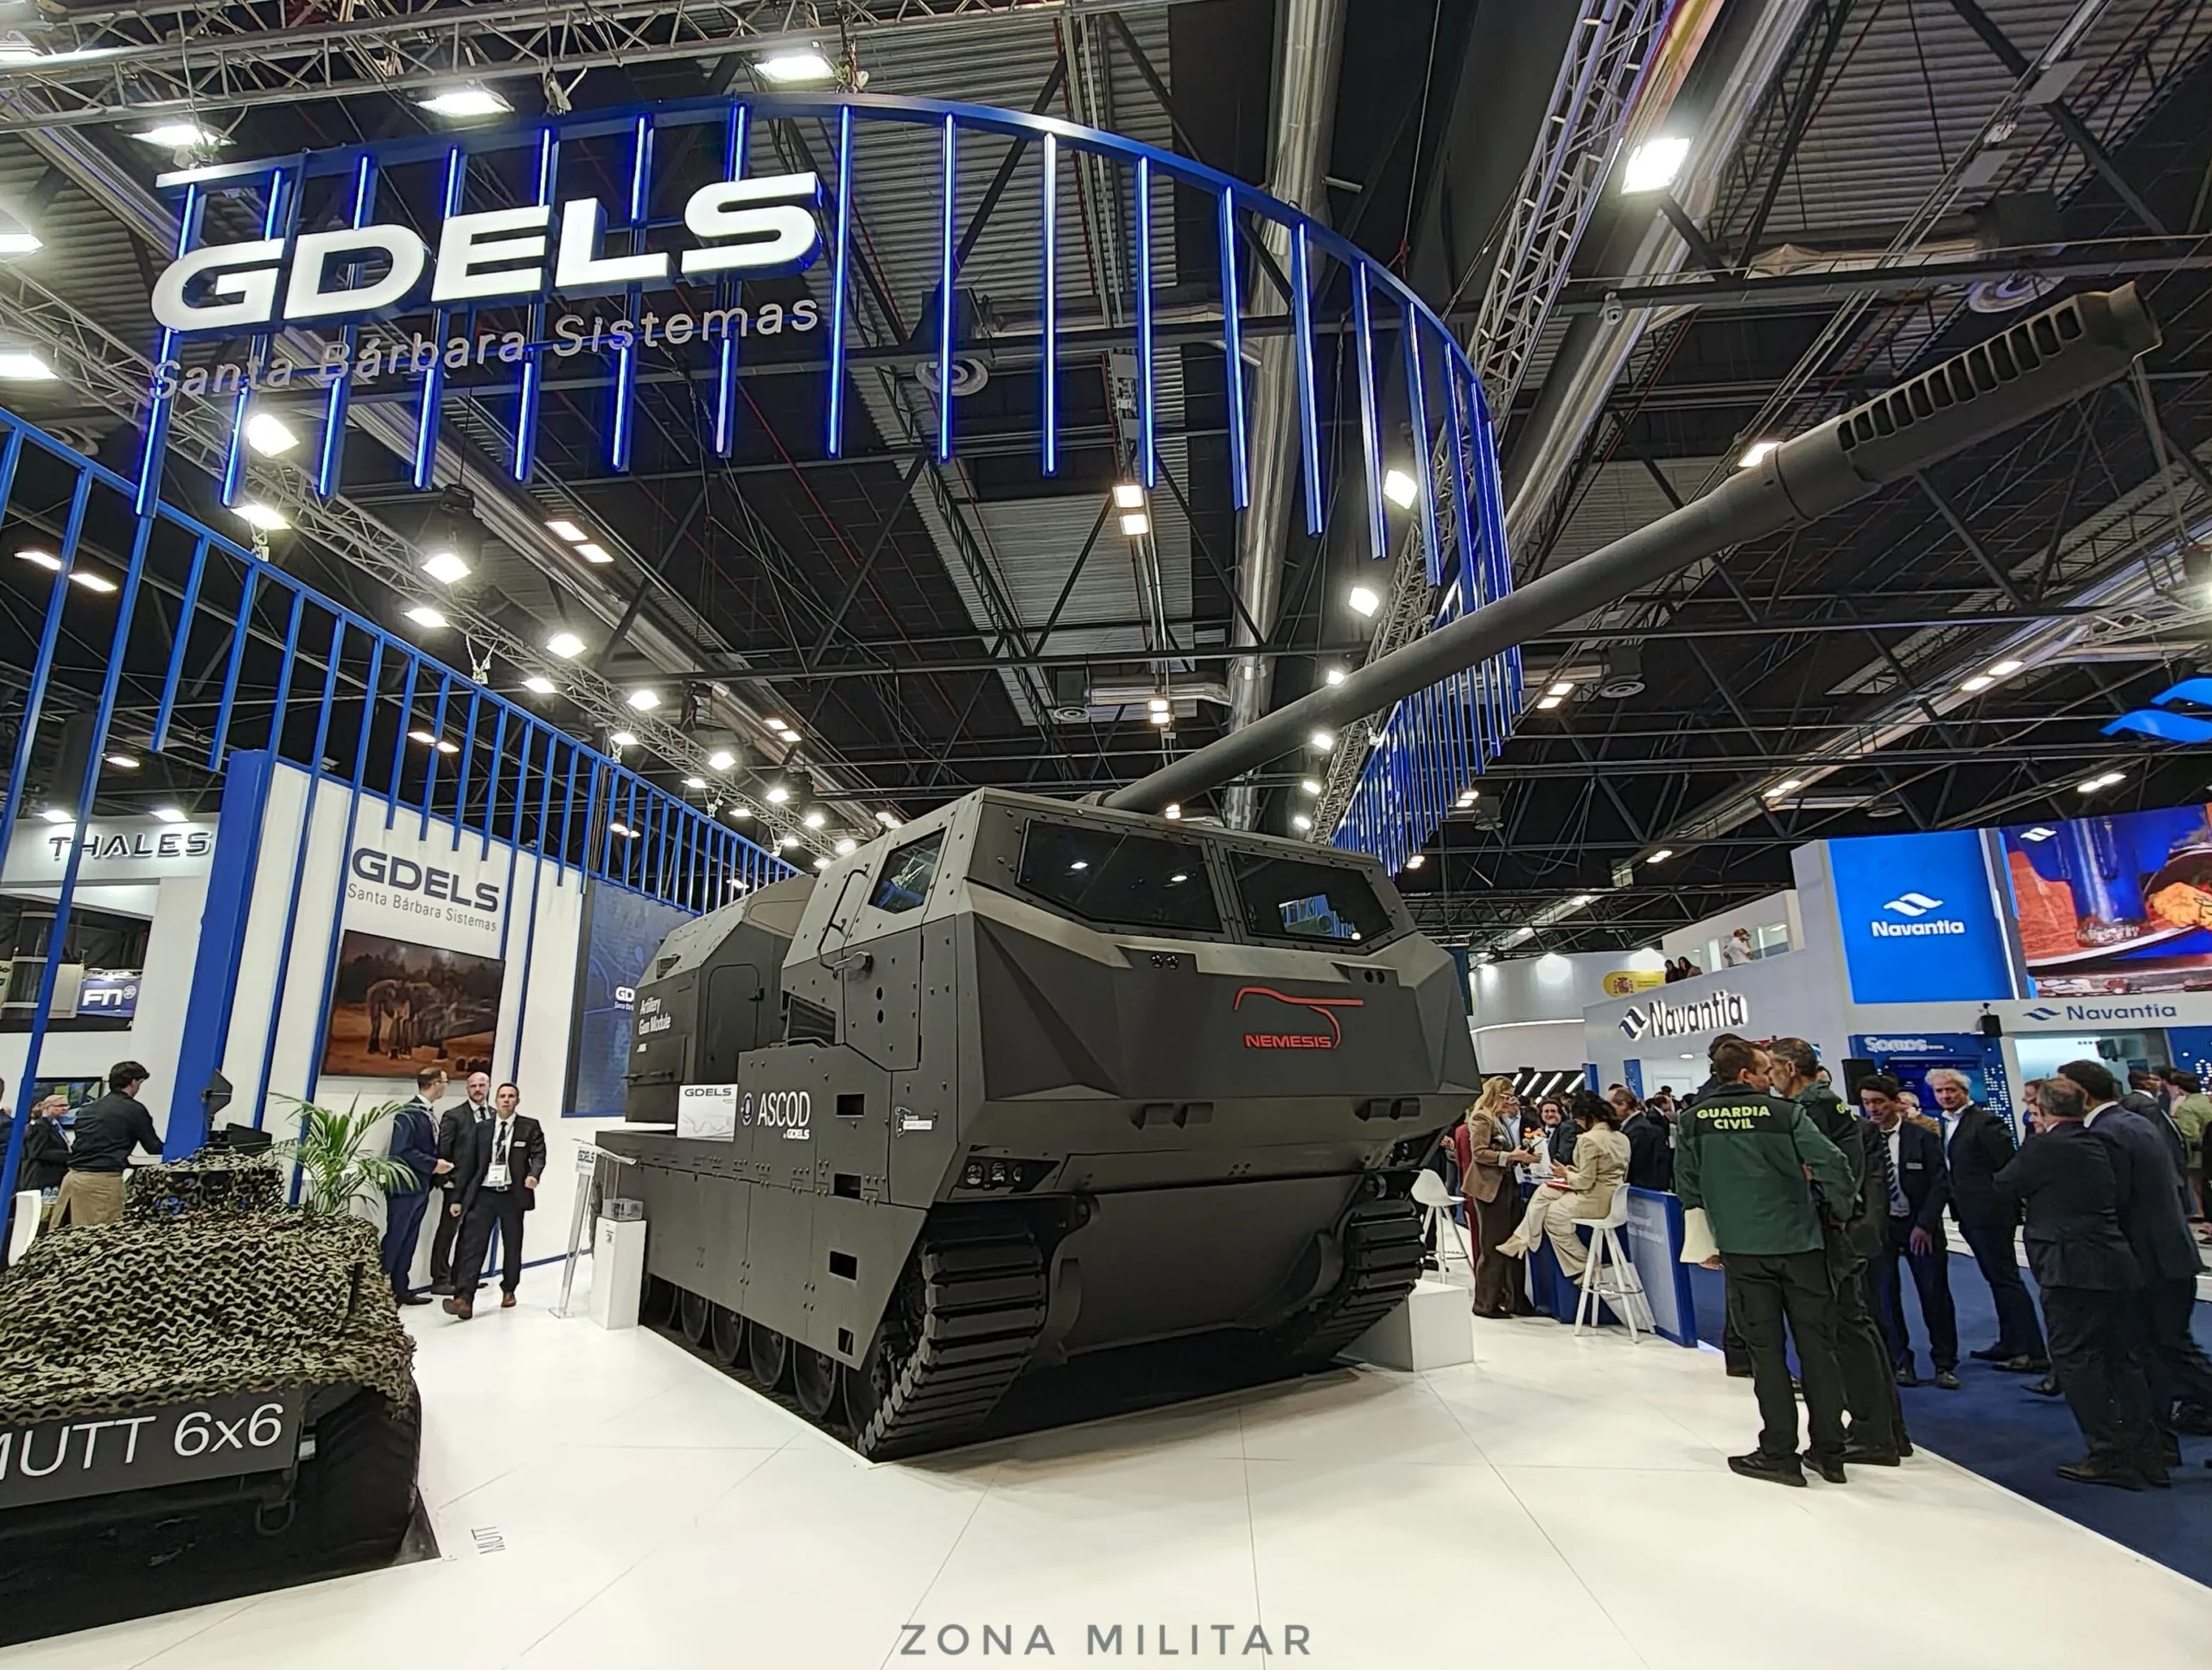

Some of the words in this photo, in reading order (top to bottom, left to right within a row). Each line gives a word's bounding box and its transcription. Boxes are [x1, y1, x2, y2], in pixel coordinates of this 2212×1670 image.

[150, 171, 822, 333] GDELS
[149, 353, 293, 399] Santa
[317, 332, 526, 382] Bárbara
[553, 296, 820, 359] Sistemas
[49, 831, 213, 860] THALES
[352, 847, 499, 913] GDELS
[347, 882, 388, 906] Santa
[392, 894, 442, 919] Bárbara
[446, 907, 498, 932] Sistemas
[1870, 919, 1966, 937] Navantia
[1648, 990, 1745, 1038] Navantia
[2066, 1003, 2177, 1021] Navantia
[1244, 1034, 1332, 1049] NEMESIS
[683, 1087, 733, 1097] GDELS
[757, 1090, 811, 1127] ASCOD
[1696, 1105, 1771, 1120] GUARDIA
[1713, 1118, 1756, 1130] CIVIL
[173, 1402, 284, 1457] 6x6
[471, 1526, 506, 1555] MUTT
